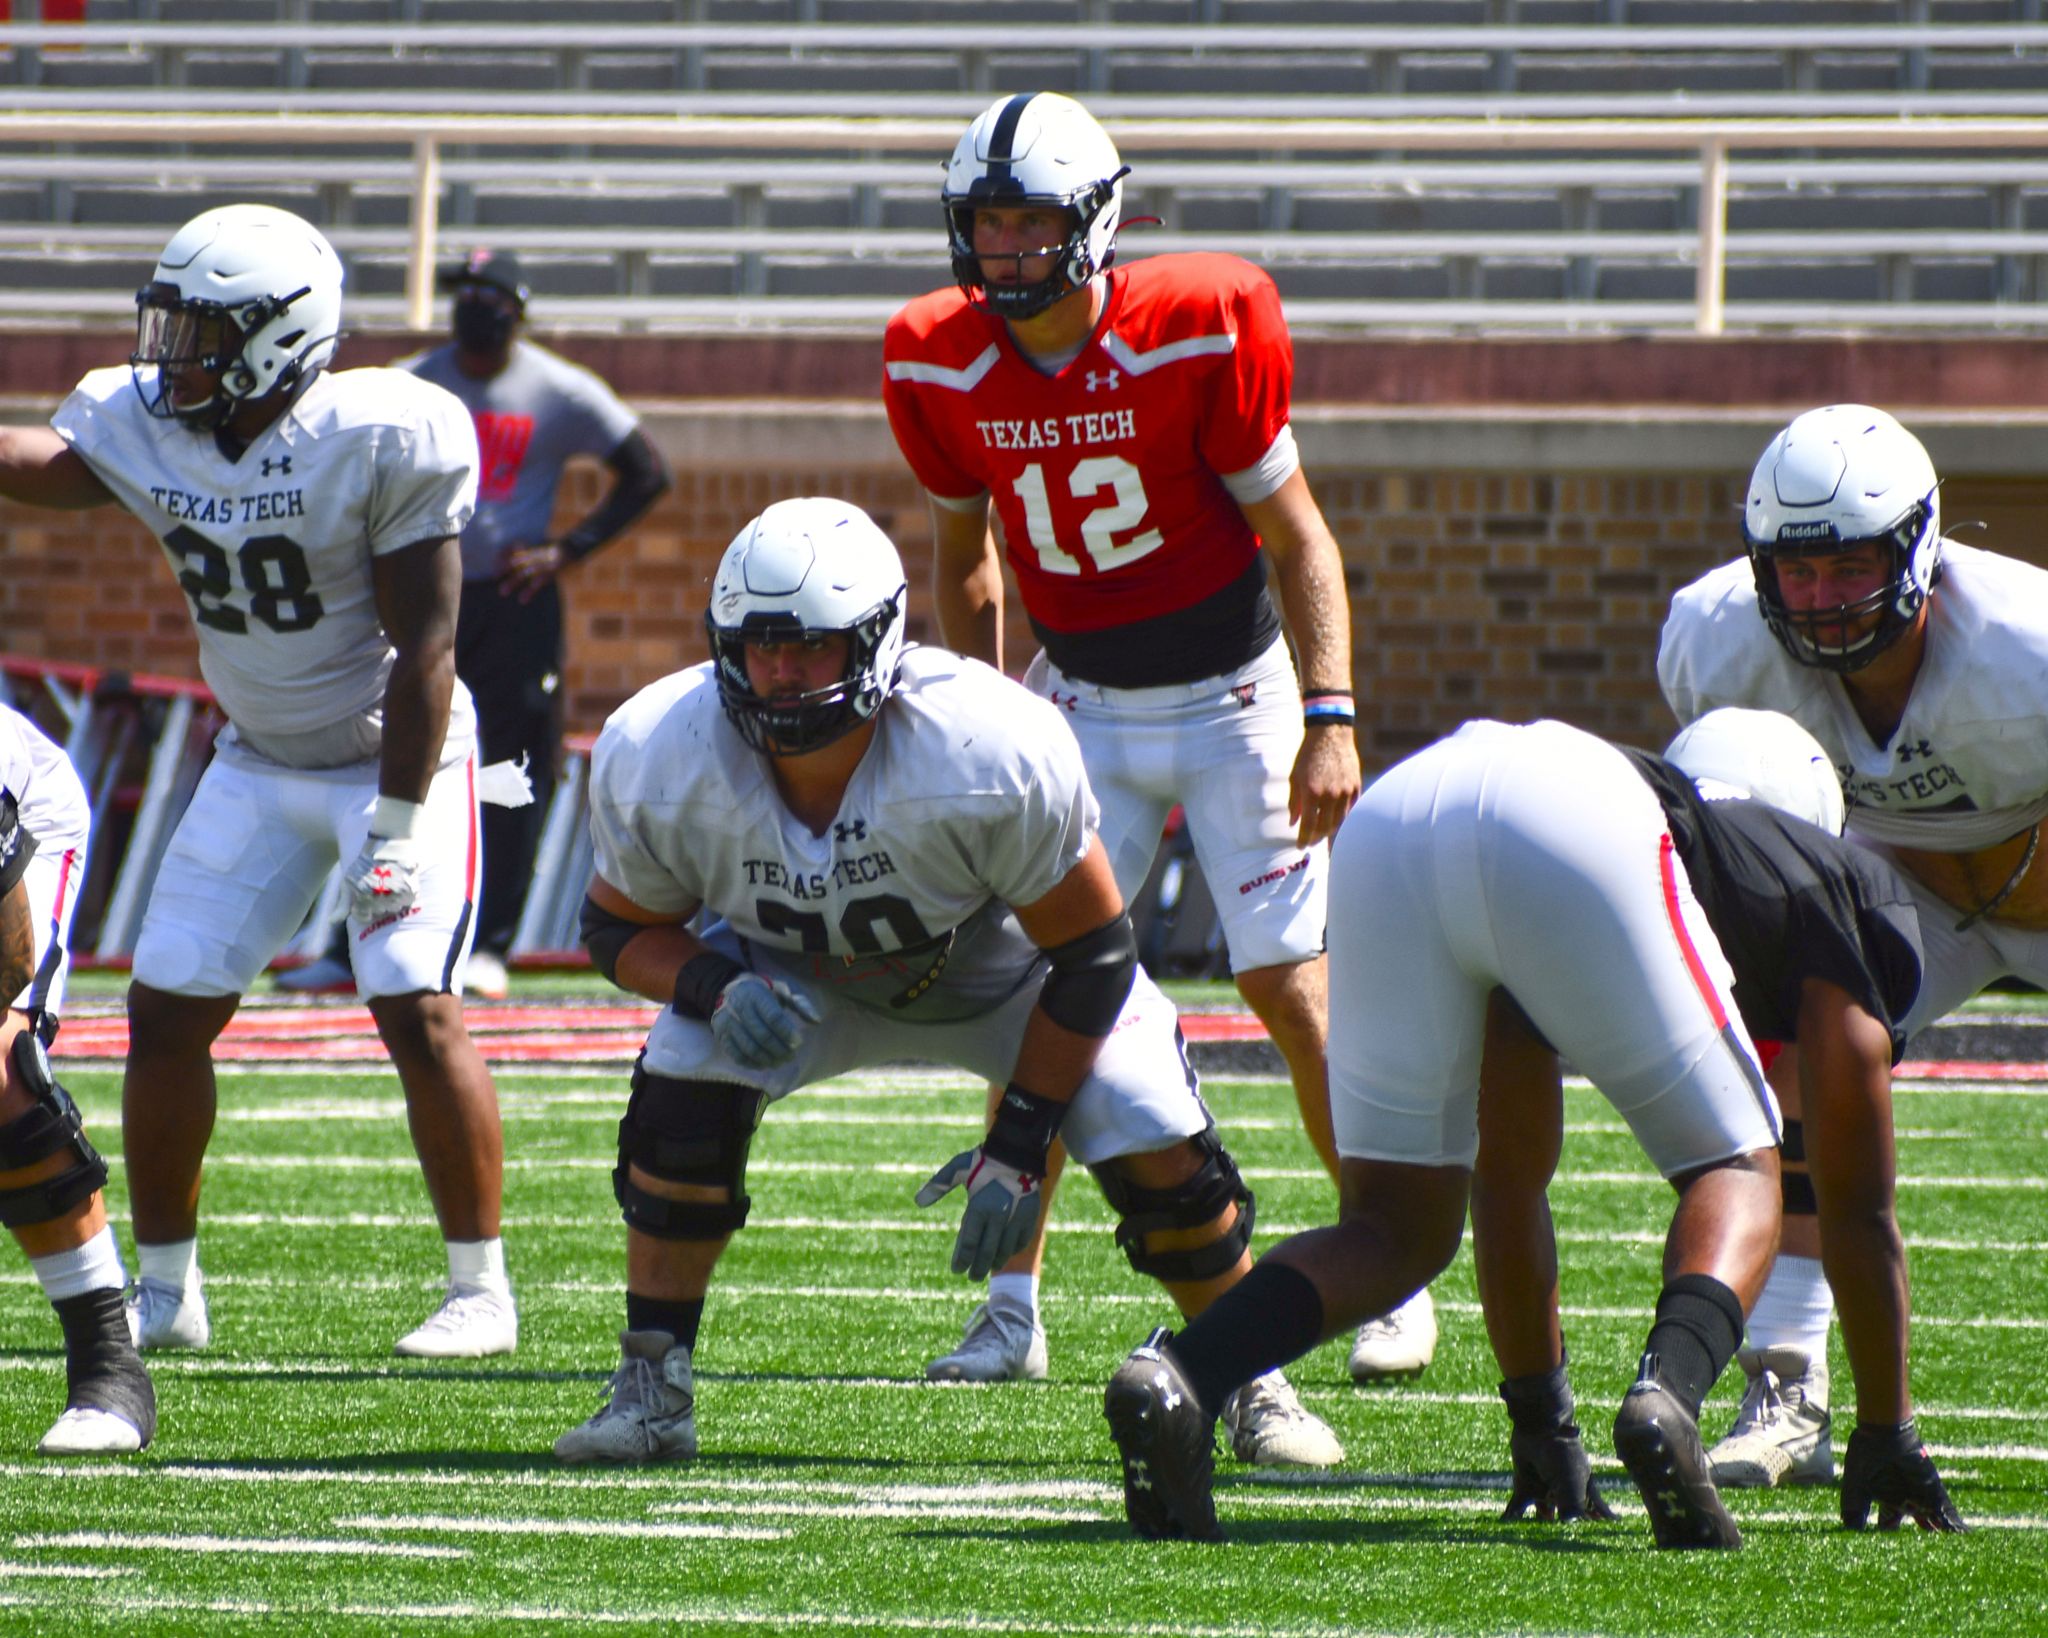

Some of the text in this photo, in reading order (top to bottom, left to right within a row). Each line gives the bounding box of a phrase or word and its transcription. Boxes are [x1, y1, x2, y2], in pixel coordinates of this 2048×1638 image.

[976, 408, 1137, 449] TEXAS TECH
[150, 487, 305, 523] TEXAS TECH
[1012, 455, 1165, 576] 12
[1781, 522, 1830, 539] Riddell
[162, 524, 325, 634] 28
[1889, 763, 1966, 800] TECH
[742, 851, 897, 900] TEXAS TECH
